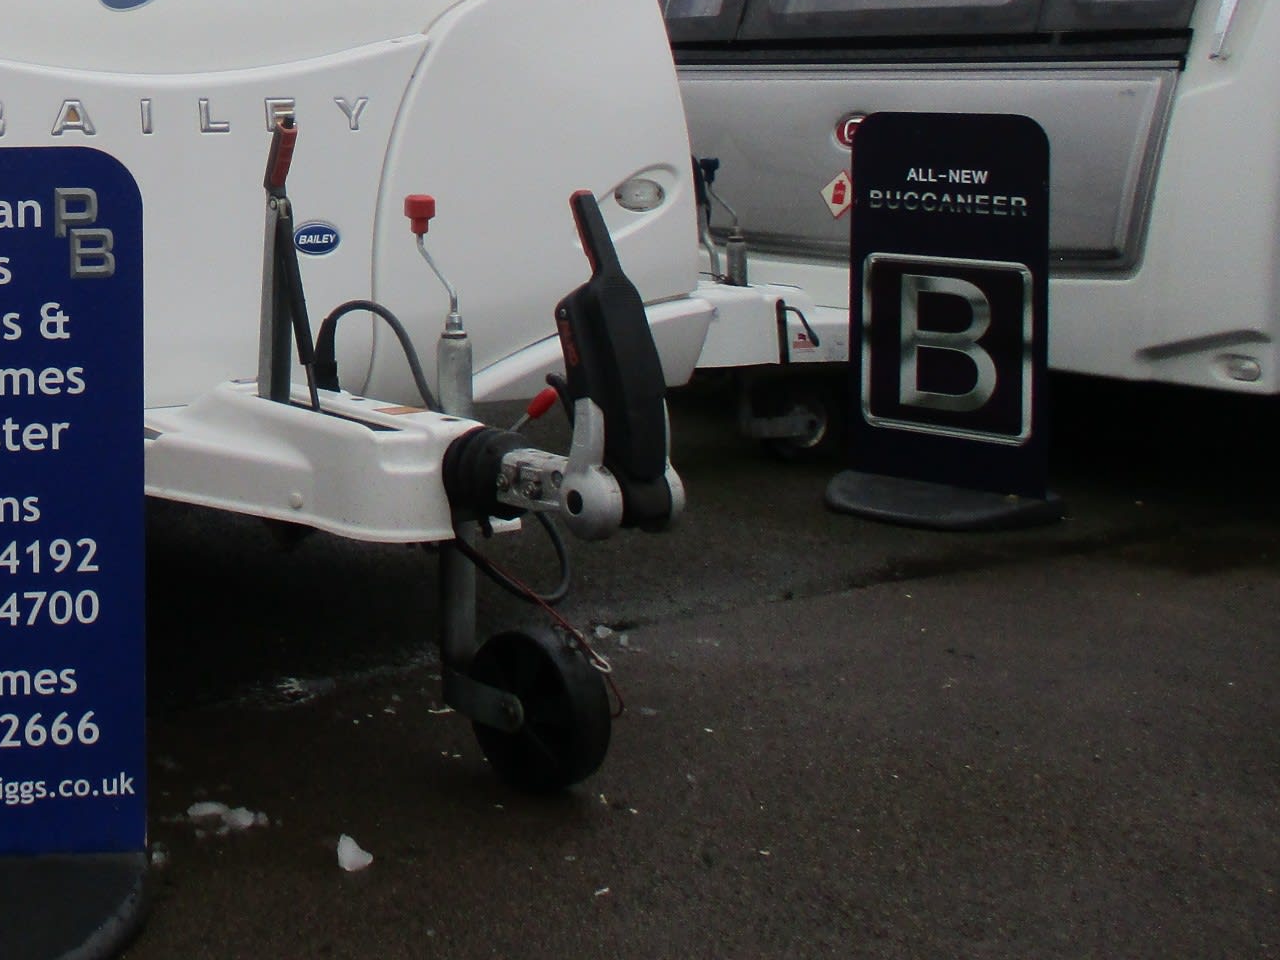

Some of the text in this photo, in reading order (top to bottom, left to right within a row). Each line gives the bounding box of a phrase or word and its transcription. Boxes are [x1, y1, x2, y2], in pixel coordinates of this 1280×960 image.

[906, 167, 989, 185] ALL-NEW
[870, 190, 1027, 217] BUCCANEER
[298, 234, 336, 245] BAILEY
[39, 302, 71, 341] &
[898, 272, 998, 412] B
